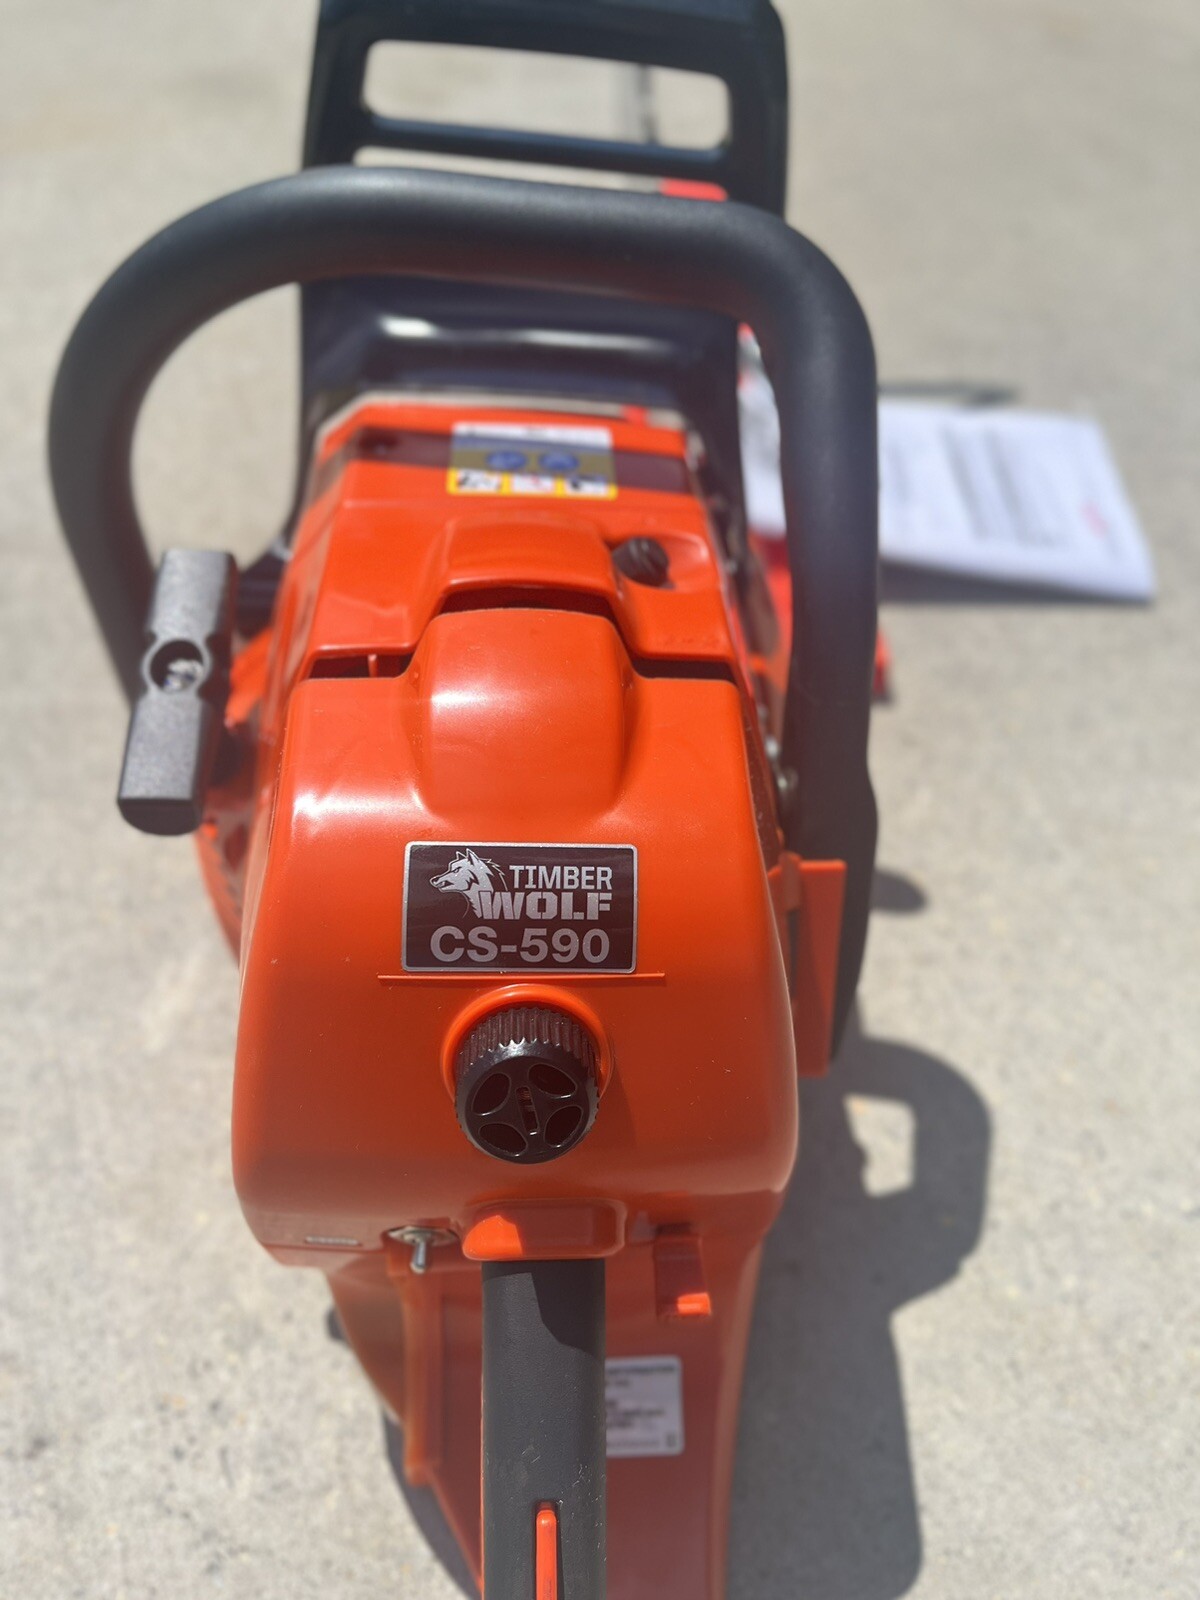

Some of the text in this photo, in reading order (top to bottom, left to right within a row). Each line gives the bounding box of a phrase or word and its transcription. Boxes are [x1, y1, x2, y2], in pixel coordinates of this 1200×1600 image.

[509, 865, 613, 890] TIMBER
[478, 891, 612, 920] WOLF
[430, 925, 610, 963] CS-590
